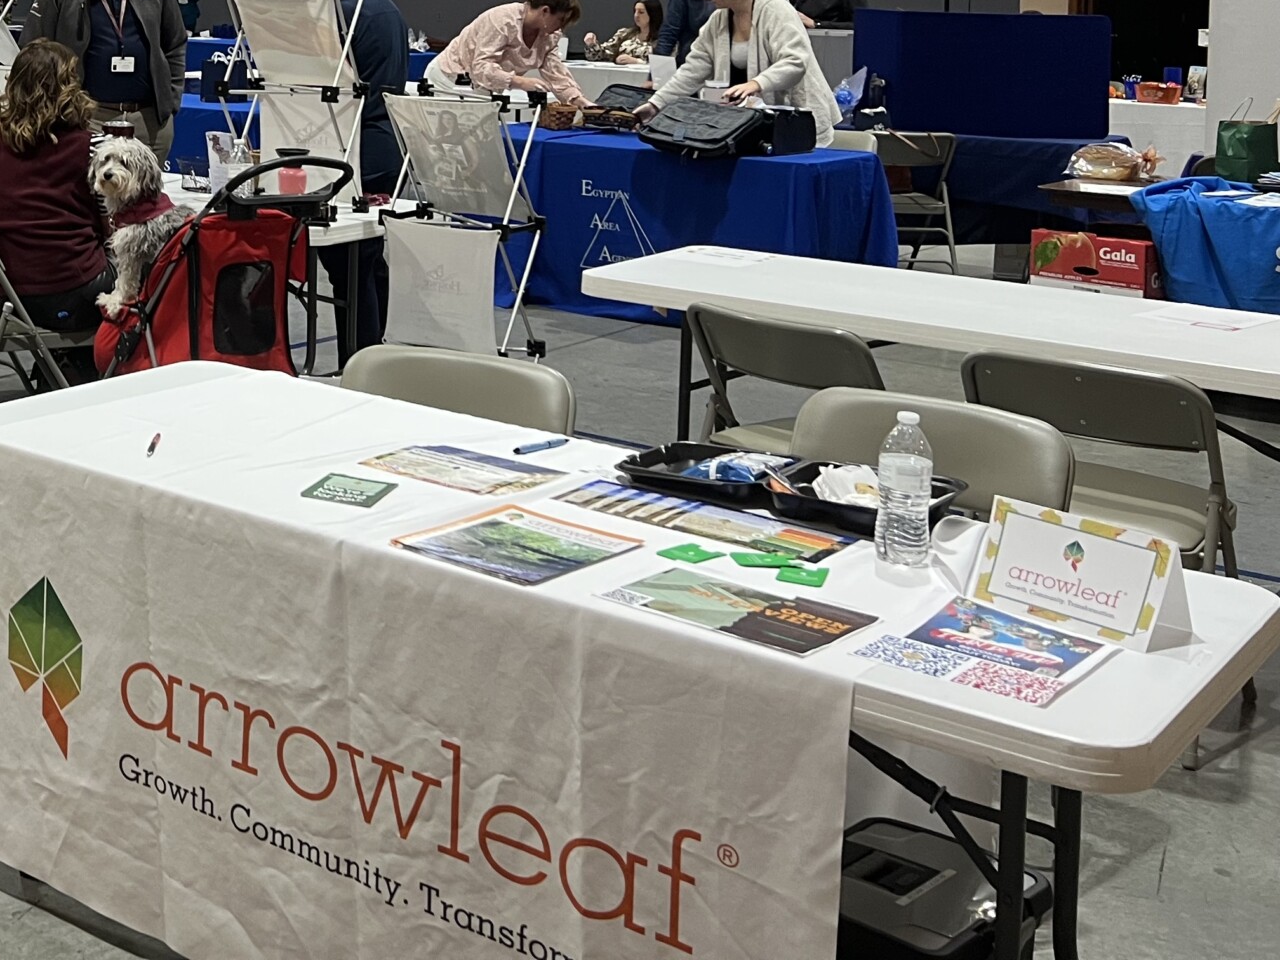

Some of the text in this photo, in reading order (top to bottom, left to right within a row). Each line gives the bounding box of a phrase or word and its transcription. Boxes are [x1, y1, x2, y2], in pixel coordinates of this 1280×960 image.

[1099, 247, 1136, 263] Gala
[1008, 566, 1123, 609] arrowleaf
[778, 607, 853, 630] OPEN
[120, 661, 702, 956] arrowleaf
[118, 753, 573, 960] Growth. Community. Transfor
